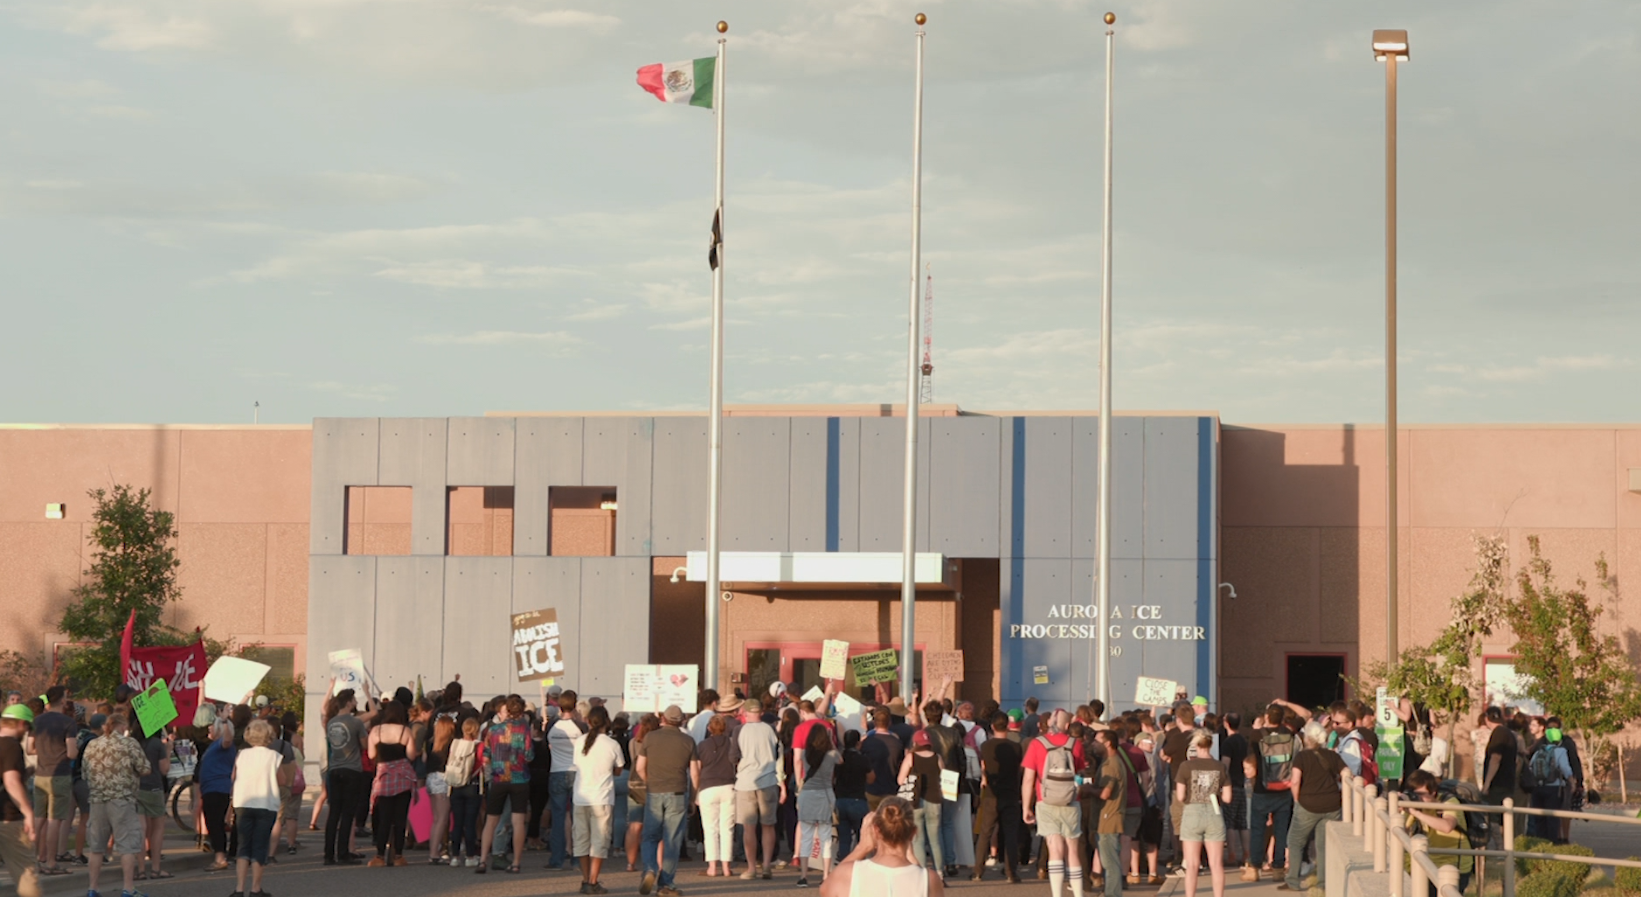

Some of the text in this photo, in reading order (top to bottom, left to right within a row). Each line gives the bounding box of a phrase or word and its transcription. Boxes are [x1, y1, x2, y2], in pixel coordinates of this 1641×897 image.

[1047, 604, 1162, 620] AUROA ICE
[1009, 624, 1206, 640] PROCESSIG CENTER
[515, 637, 564, 677] ICE
[1144, 679, 1168, 691] CLOSE
[1142, 693, 1167, 706] CAMPS
[1384, 707, 1391, 721] 5
